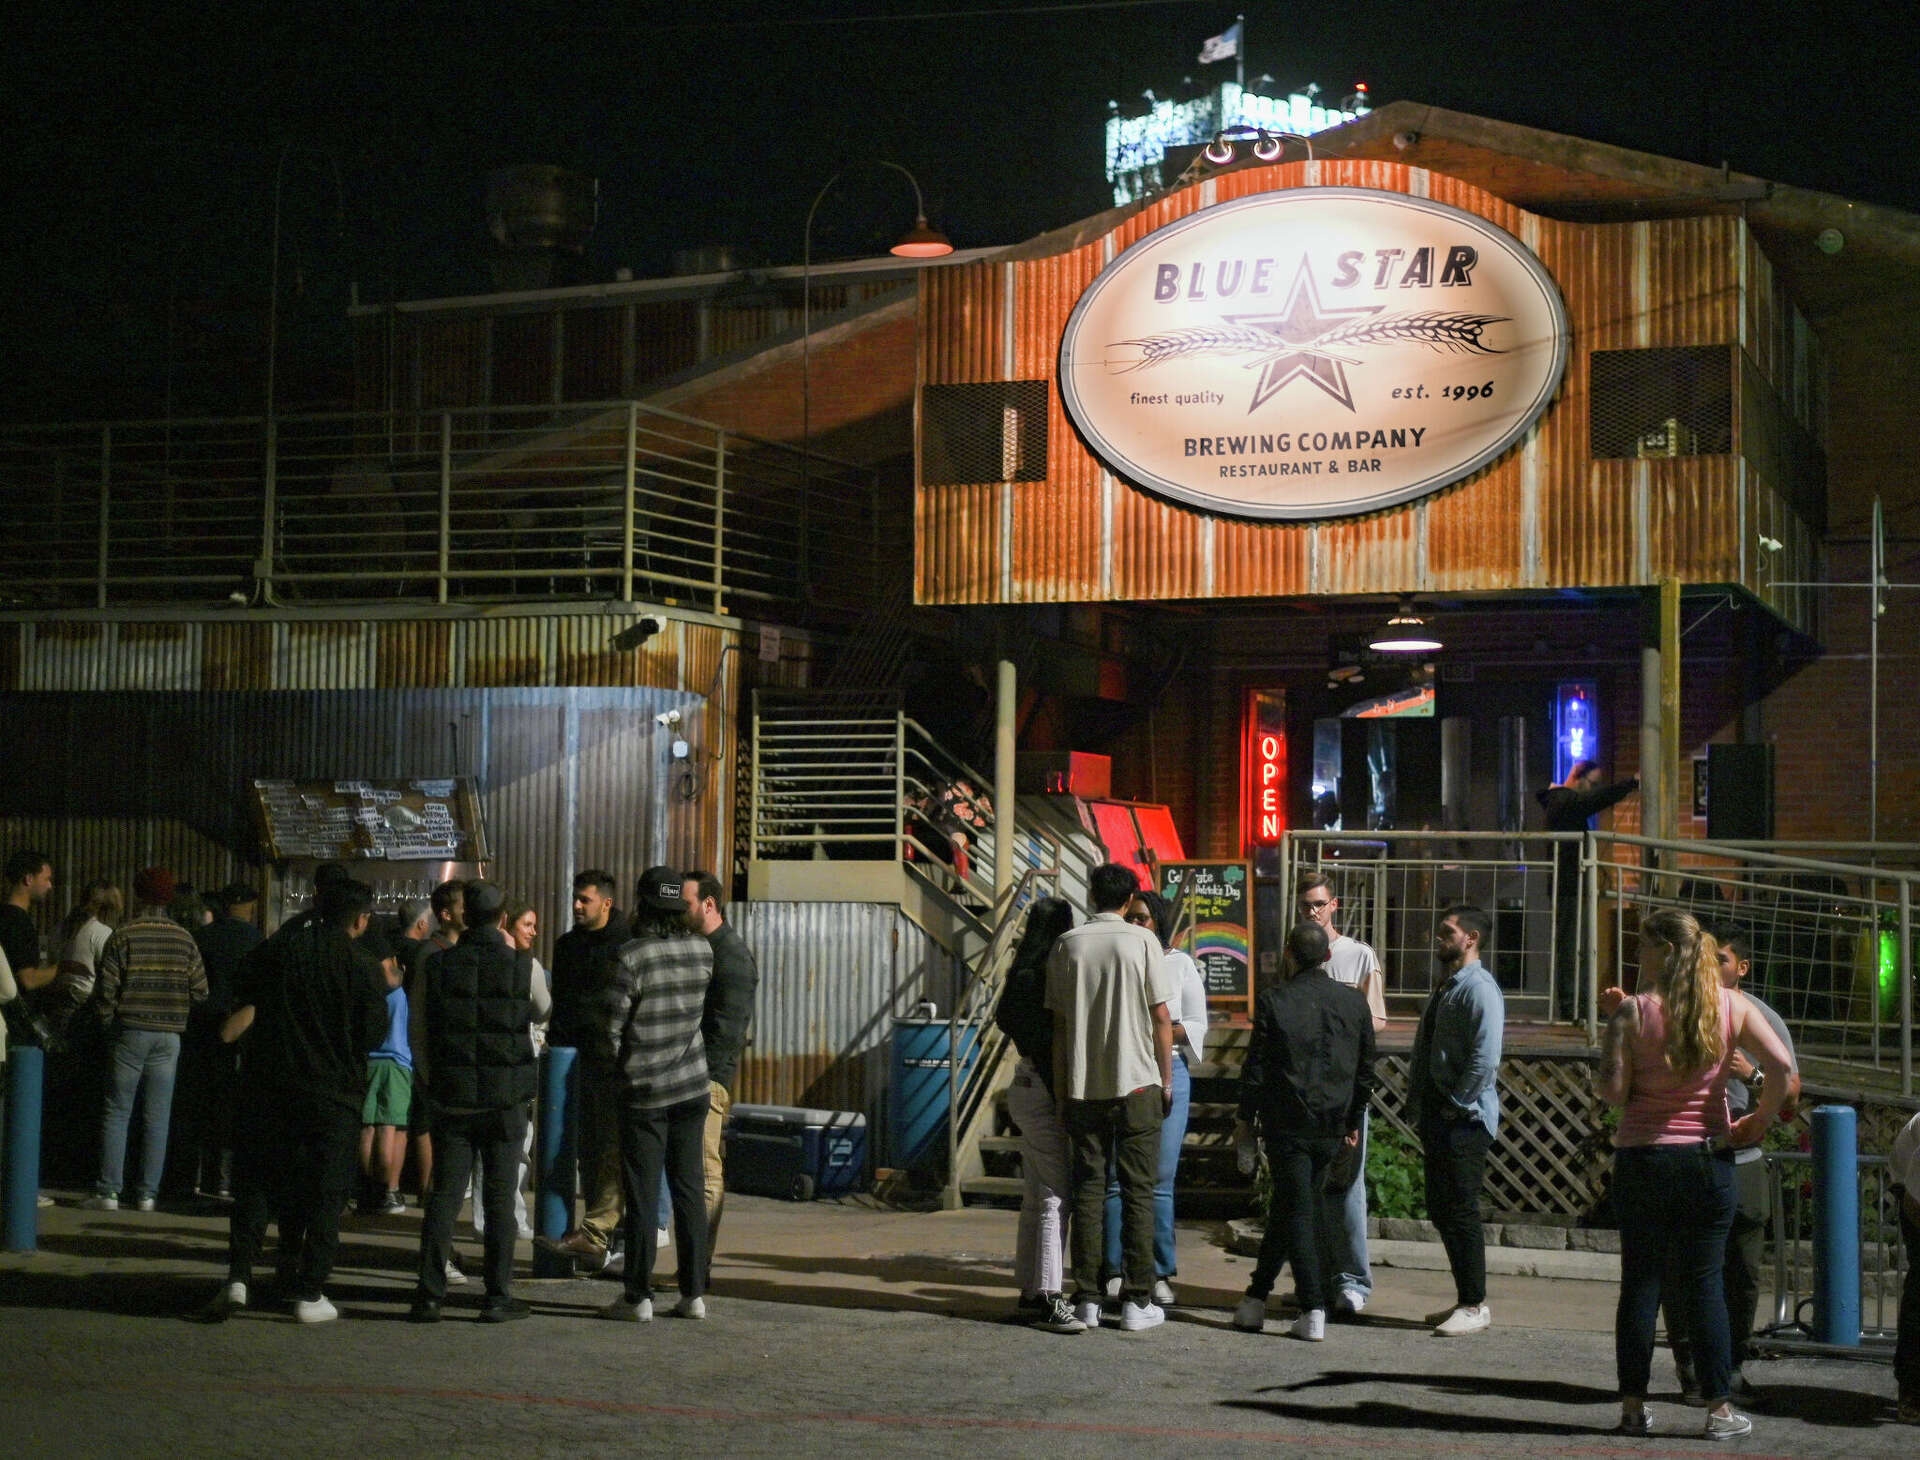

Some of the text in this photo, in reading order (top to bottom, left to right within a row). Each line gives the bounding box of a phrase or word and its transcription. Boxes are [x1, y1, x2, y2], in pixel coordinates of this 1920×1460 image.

[1153, 245, 1478, 304] BLUE STAR
[1130, 391, 1225, 406] finest quality
[1391, 380, 1494, 402] est. 1996
[1184, 427, 1427, 457] BREWING COMPANY
[1220, 459, 1382, 478] RESTAURANT & BAR
[1261, 736, 1280, 838] OPEN
[1224, 884, 1241, 900] Day
